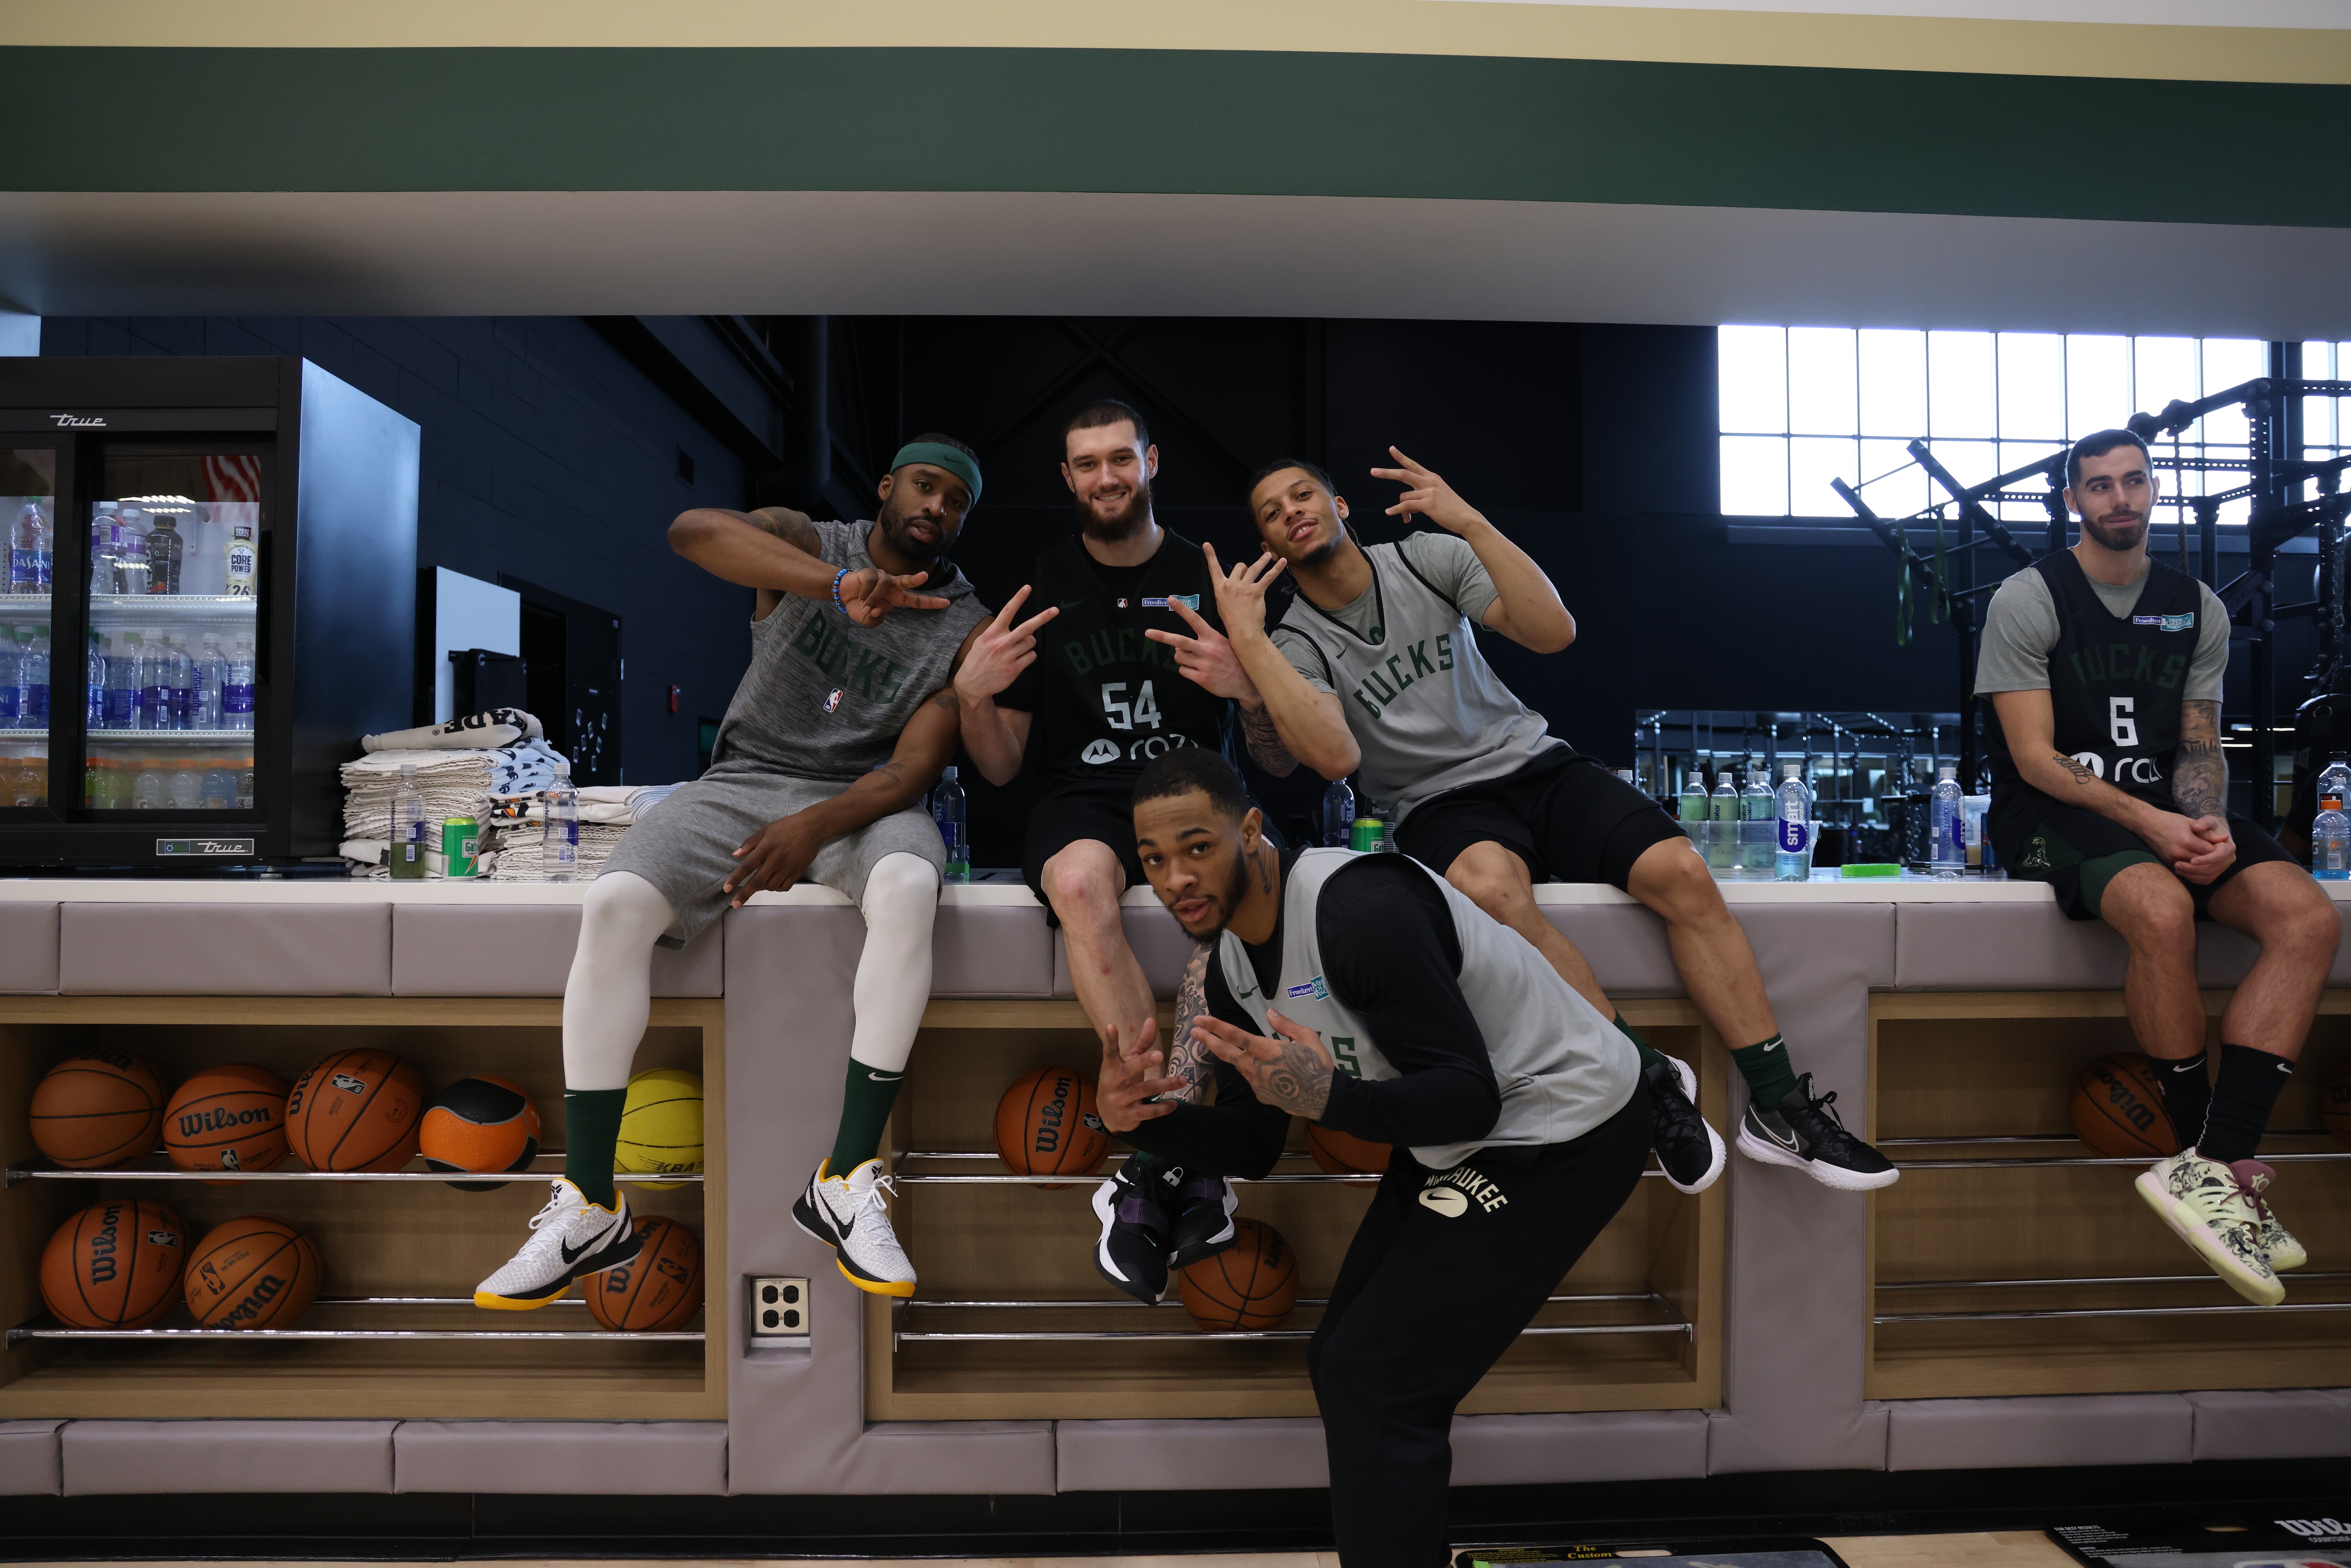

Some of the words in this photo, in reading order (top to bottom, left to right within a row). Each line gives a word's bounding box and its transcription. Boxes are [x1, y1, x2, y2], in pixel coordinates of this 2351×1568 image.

[50, 414, 107, 426] true
[13, 556, 50, 570] DASANI
[231, 555, 252, 566] CORE
[231, 565, 251, 573] POWER
[792, 609, 910, 704] BUCKS
[1102, 680, 1162, 730] 54
[2110, 696, 2139, 747] 6
[1787, 800, 1799, 846] smart
[197, 842, 246, 853] true
[179, 1107, 273, 1138] Wilson
[1035, 1077, 1072, 1153] Wilson
[92, 1205, 121, 1286] Wilson
